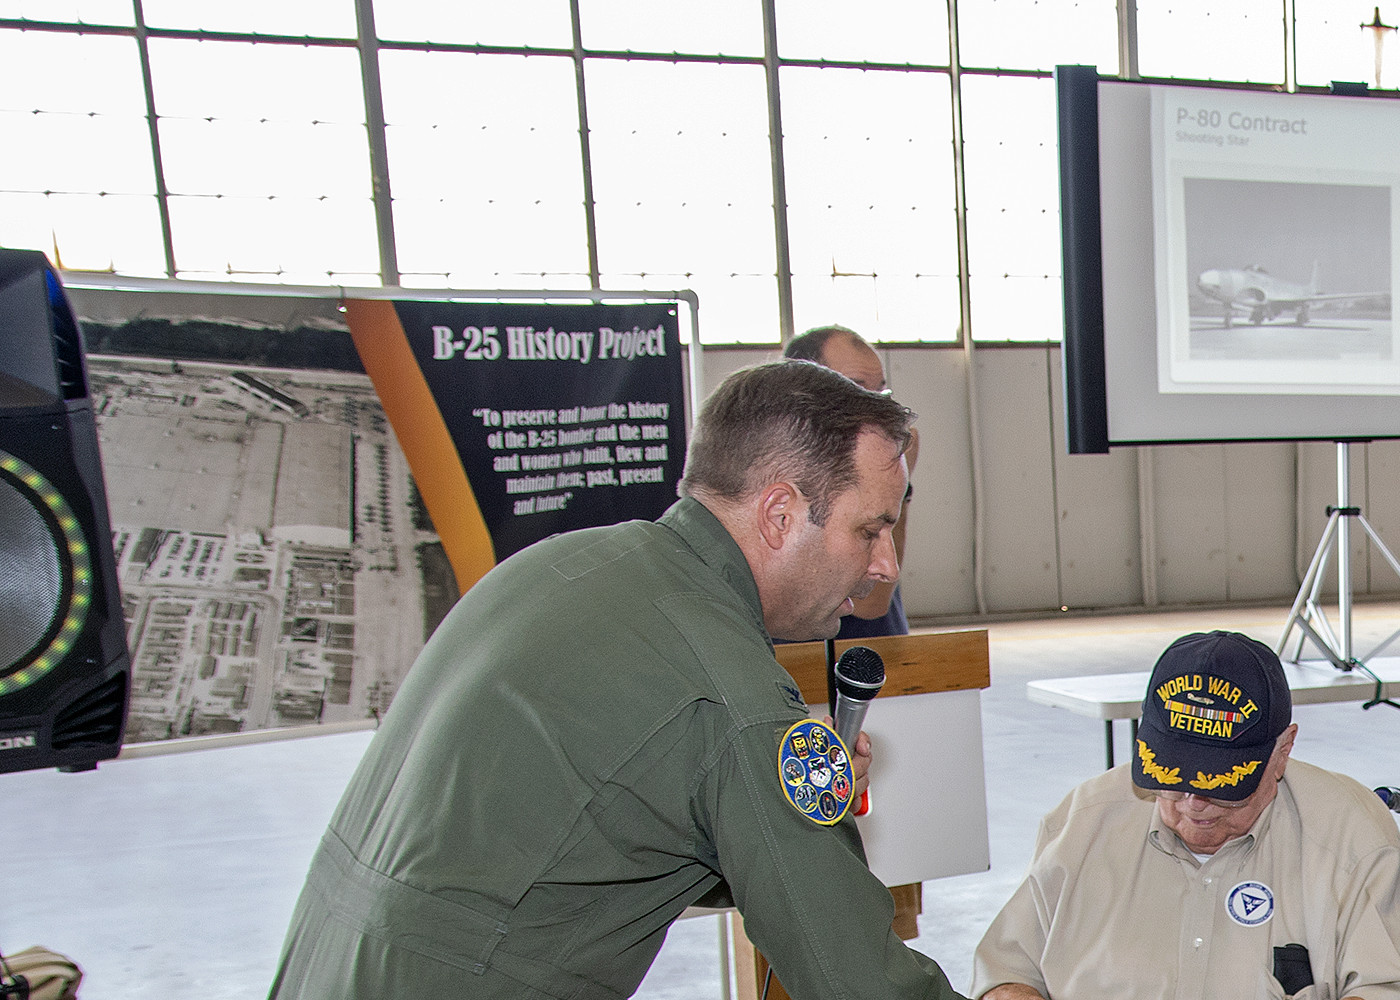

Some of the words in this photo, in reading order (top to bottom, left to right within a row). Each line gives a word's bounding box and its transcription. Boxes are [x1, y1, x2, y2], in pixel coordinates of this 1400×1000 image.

[1176, 107, 1221, 128] P-80
[1228, 111, 1307, 135] Contract
[432, 325, 502, 361] B-25
[506, 326, 595, 365] History
[598, 324, 667, 361] Project
[502, 409, 558, 429] preserve
[557, 405, 580, 424] and
[607, 402, 628, 420] the
[627, 401, 670, 421] history
[487, 430, 504, 450] of
[504, 430, 527, 450] the
[527, 429, 558, 449] B-25
[595, 423, 619, 442] and
[618, 423, 641, 441] the
[641, 424, 670, 441] men
[493, 453, 521, 473] and
[520, 452, 562, 472] women
[615, 444, 644, 463] flew
[644, 443, 669, 462] and
[618, 465, 665, 487] present
[513, 496, 536, 517] and
[1156, 674, 1203, 702] WORLD
[1208, 676, 1242, 706] WAR
[1239, 699, 1259, 720] II
[1169, 711, 1233, 738] VETERAN
